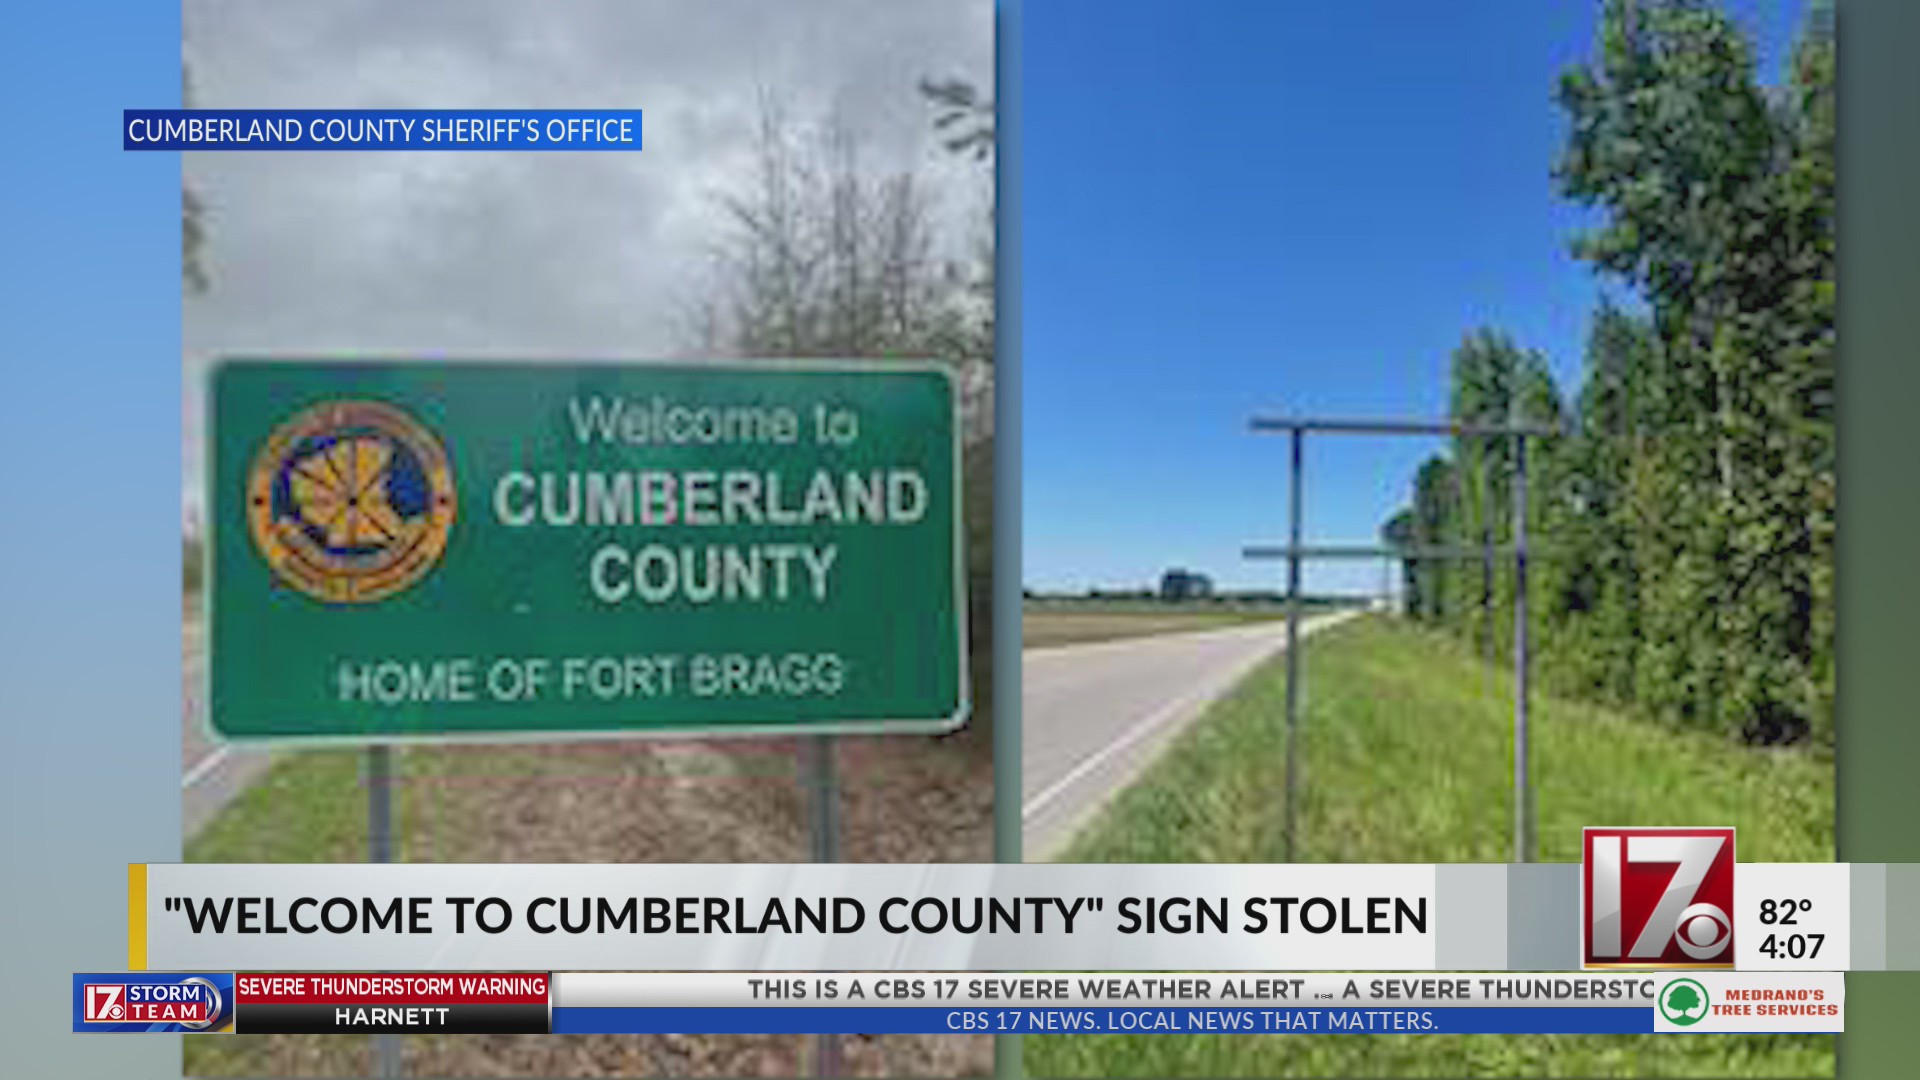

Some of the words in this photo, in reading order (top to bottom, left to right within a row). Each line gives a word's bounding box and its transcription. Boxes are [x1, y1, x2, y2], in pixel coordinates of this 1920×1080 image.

[569, 397, 799, 445] Welcome
[814, 403, 859, 445] to
[493, 470, 928, 527] CUMBERLAND
[589, 543, 838, 603] COUNTY
[337, 660, 474, 704] HOME
[486, 657, 549, 702] OF
[562, 655, 677, 700] FORT
[690, 653, 845, 697] BRAGG
